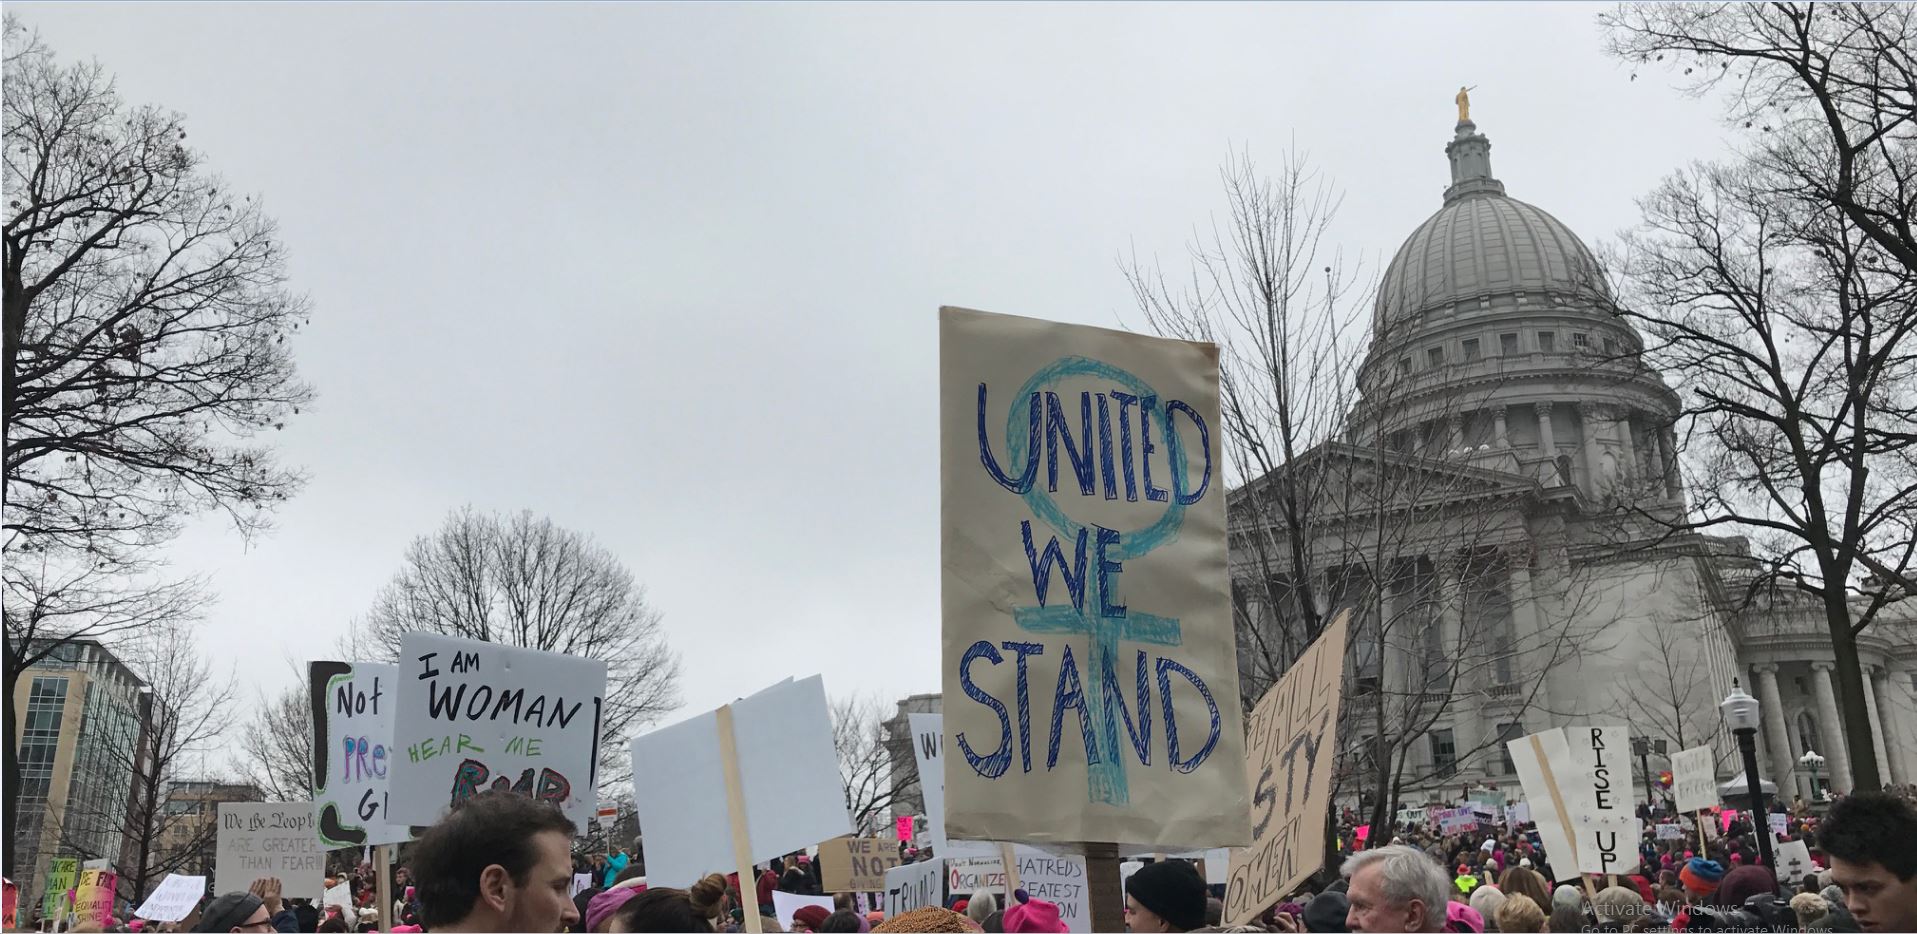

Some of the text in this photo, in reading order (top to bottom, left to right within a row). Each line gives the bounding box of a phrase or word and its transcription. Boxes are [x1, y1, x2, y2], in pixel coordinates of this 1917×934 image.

[978, 383, 1212, 505] UNITED
[1021, 520, 1127, 619] WE
[418, 650, 480, 680] I AM
[429, 680, 583, 729] WOMAN
[956, 640, 1222, 778] STAND
[342, 734, 391, 784] PRe
[408, 733, 543, 763] HEAR ME
[1591, 728, 1613, 810] RISE
[224, 811, 316, 832] We the Peopl
[227, 837, 255, 853] ARE
[847, 841, 897, 853] WE ARE
[1595, 831, 1617, 873] UP
[240, 856, 273, 871] THAN
[852, 856, 898, 877] NOT
[951, 869, 1006, 889] ORGANIZE
[889, 870, 936, 917] TRUMP
